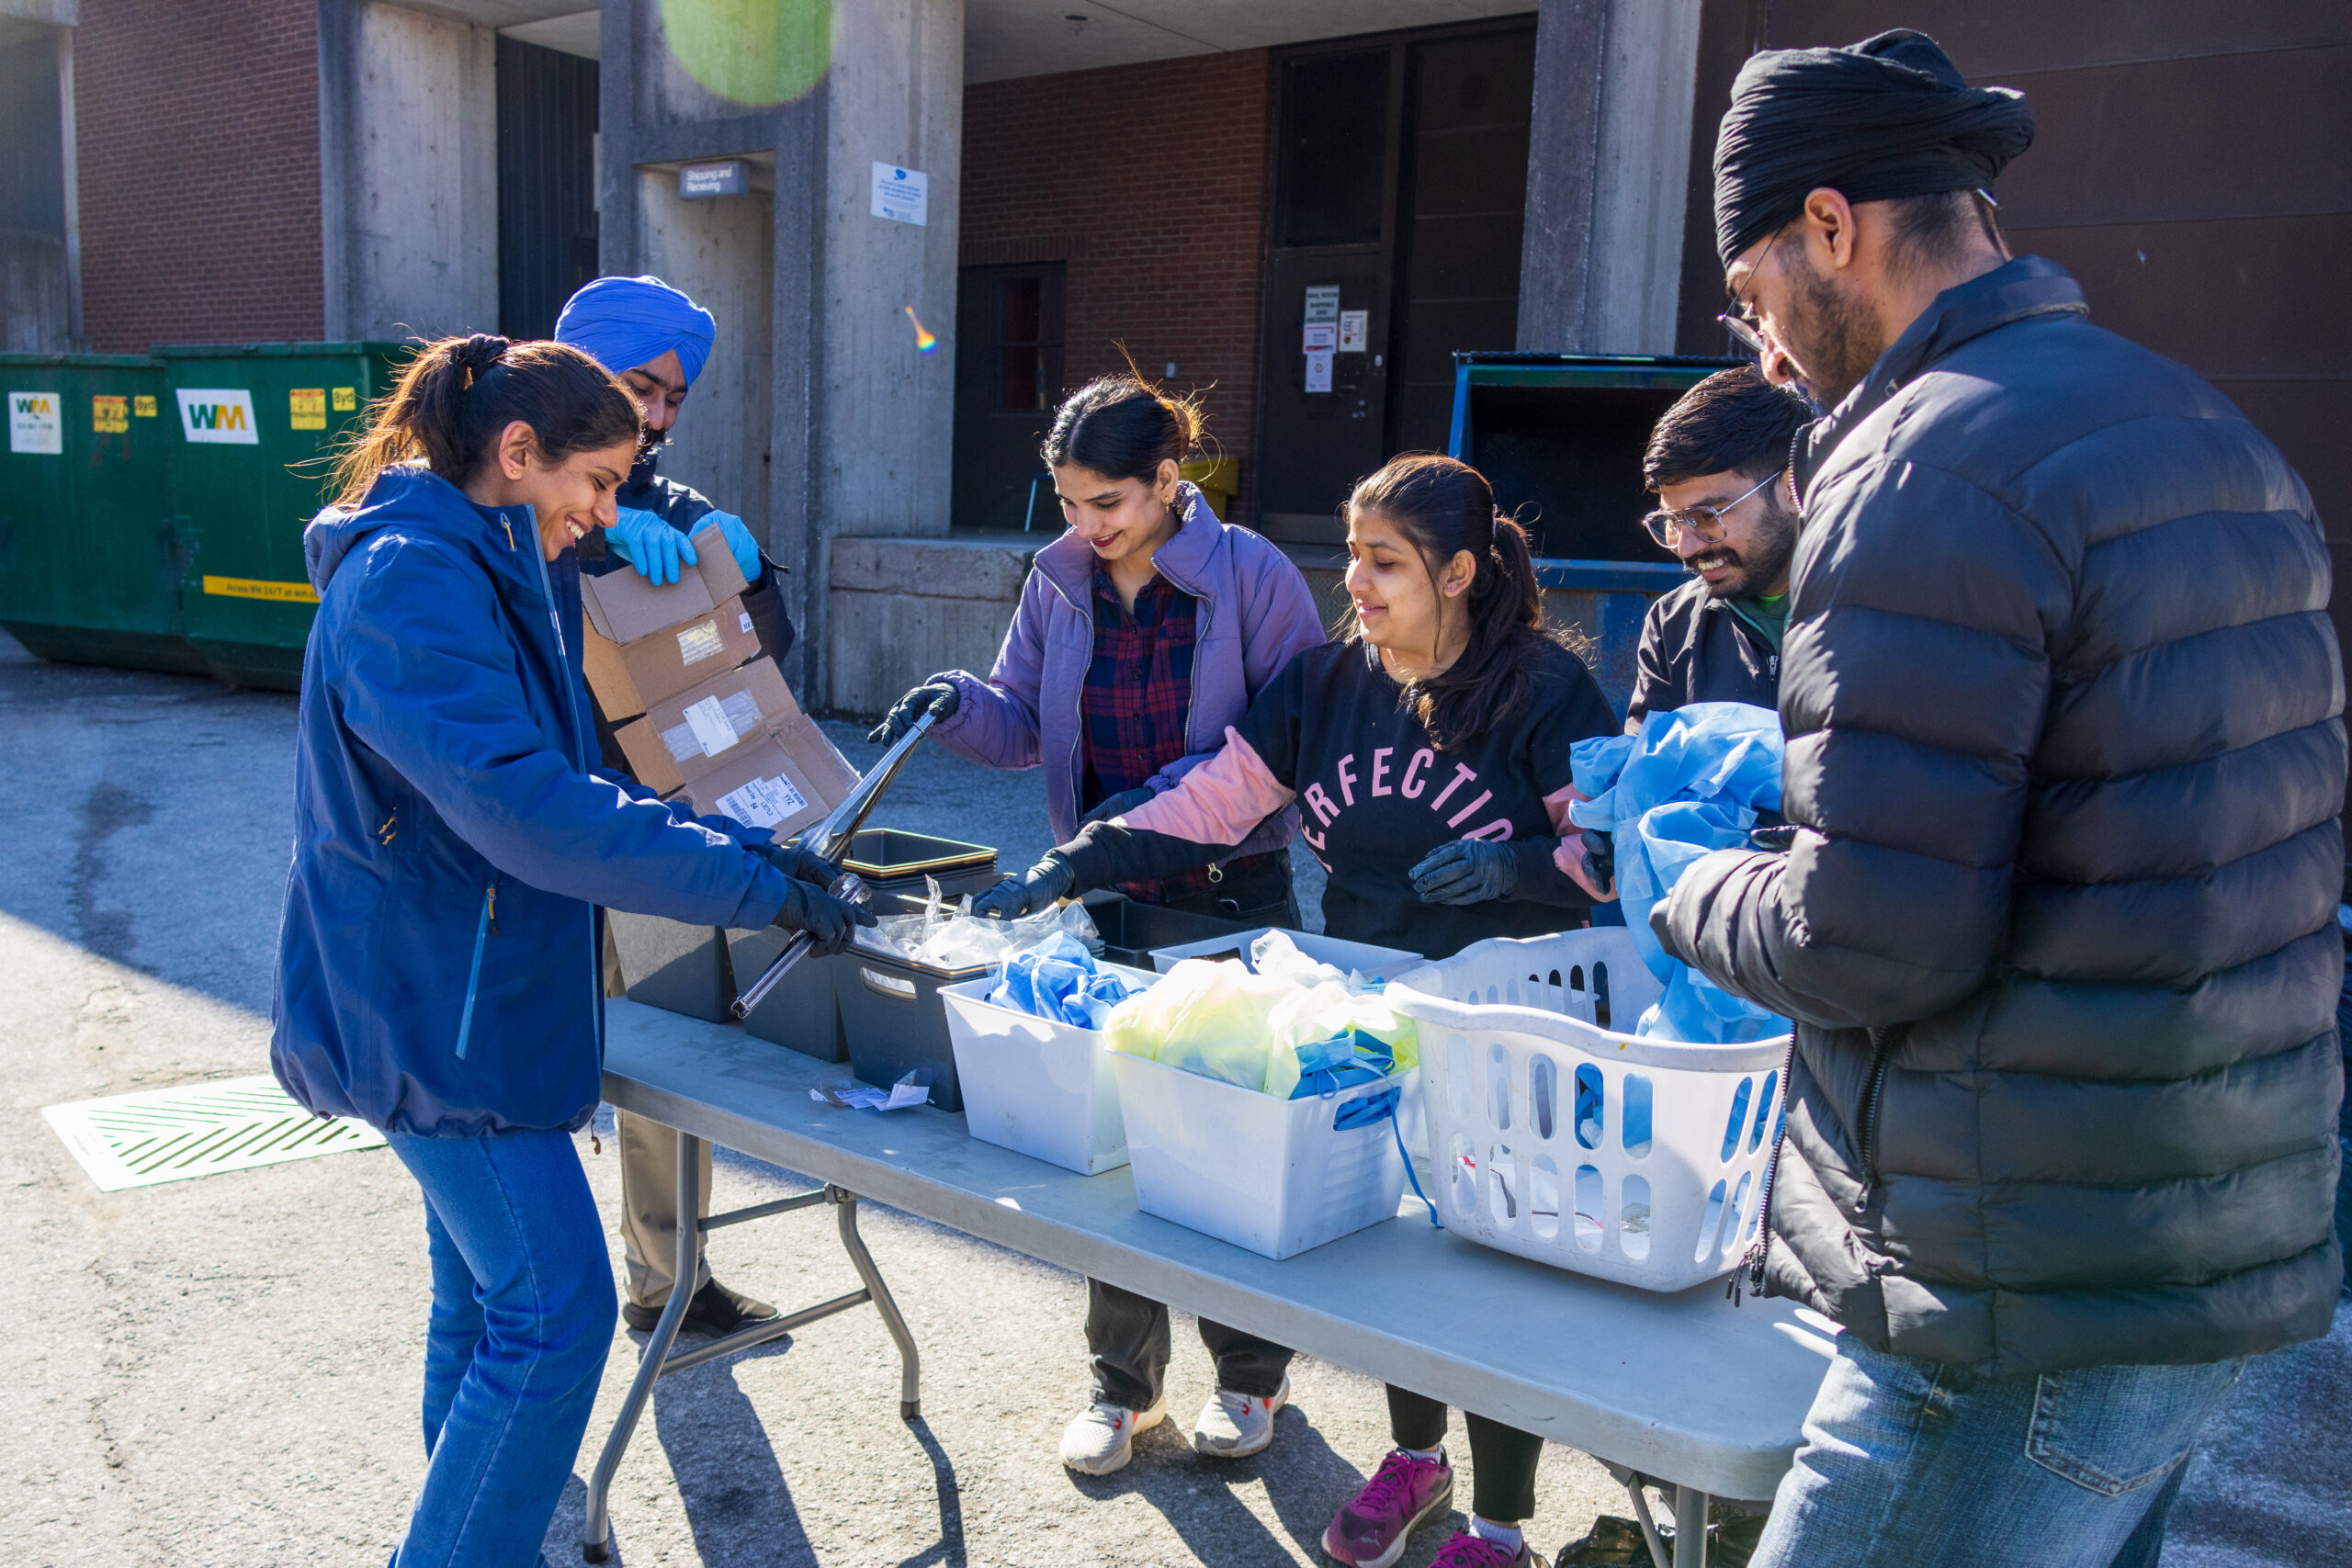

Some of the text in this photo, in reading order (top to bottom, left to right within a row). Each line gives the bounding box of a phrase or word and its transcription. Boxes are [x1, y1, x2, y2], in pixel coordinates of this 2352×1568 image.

[686, 166, 732, 181] Shipping and
[686, 181, 721, 192] Receiving
[187, 404, 246, 431] WM
[264, 587, 282, 596] 24/7
